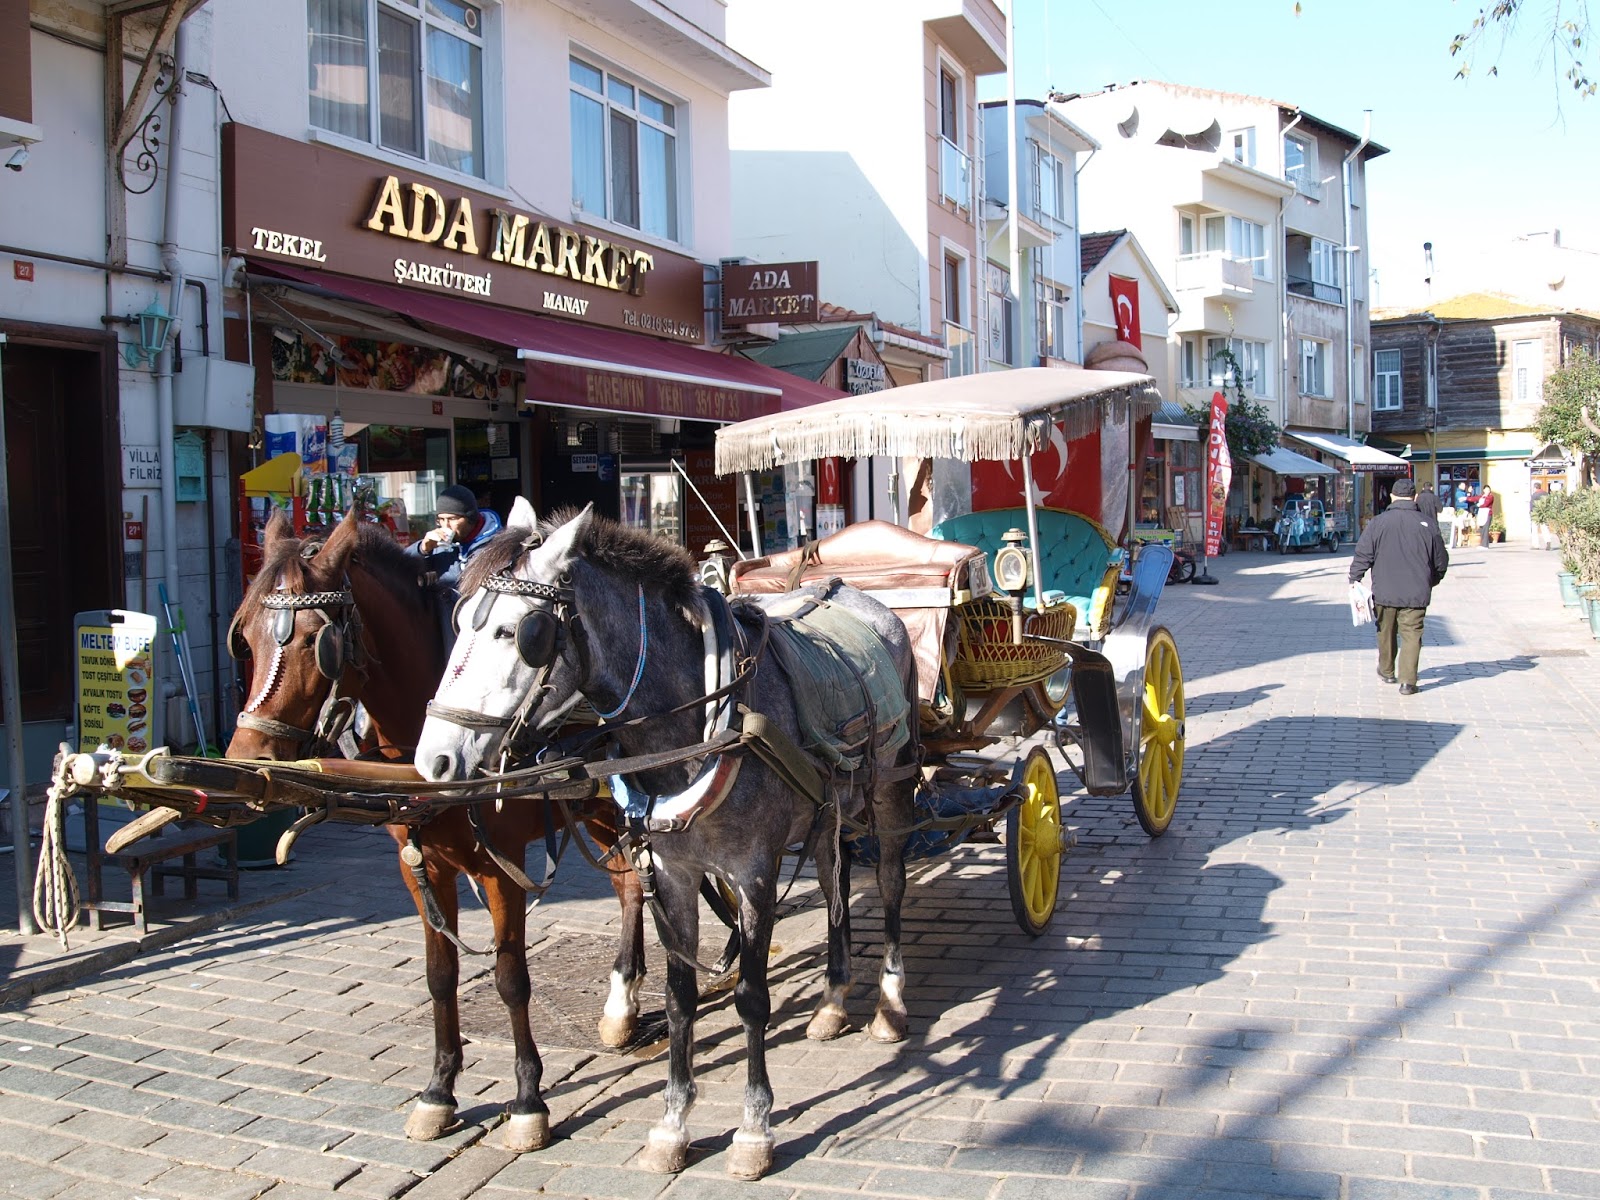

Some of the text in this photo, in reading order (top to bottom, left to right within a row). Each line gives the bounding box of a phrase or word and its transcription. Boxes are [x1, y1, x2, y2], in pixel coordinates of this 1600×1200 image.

[365, 175, 654, 297] ADA MARKET
[251, 227, 327, 263] TEKEL
[19, 265, 30, 277] 27
[394, 258, 492, 297] ŞARKÜTERİ
[748, 269, 791, 291] ADA
[542, 292, 590, 316] MANAV
[728, 294, 814, 317] MARKET
[623, 309, 639, 326] Tel.
[641, 313, 661, 331] 0216
[679, 321, 689, 337] 97
[690, 324, 700, 340] 33
[695, 388, 712, 416] 351
[714, 391, 725, 417] 97
[728, 393, 740, 419] 33
[129, 449, 160, 463] VİLLA
[572, 456, 597, 464] SETCARD
[696, 458, 715, 468] AD
[81, 633, 120, 651] MELTEM
[81, 656, 99, 666] TAVUK
[82, 670, 96, 680] TOST
[82, 688, 122, 699] AYVALIK TOSTU
[83, 703, 101, 714] KÖFTE
[84, 718, 104, 729] SOSİSLİ
